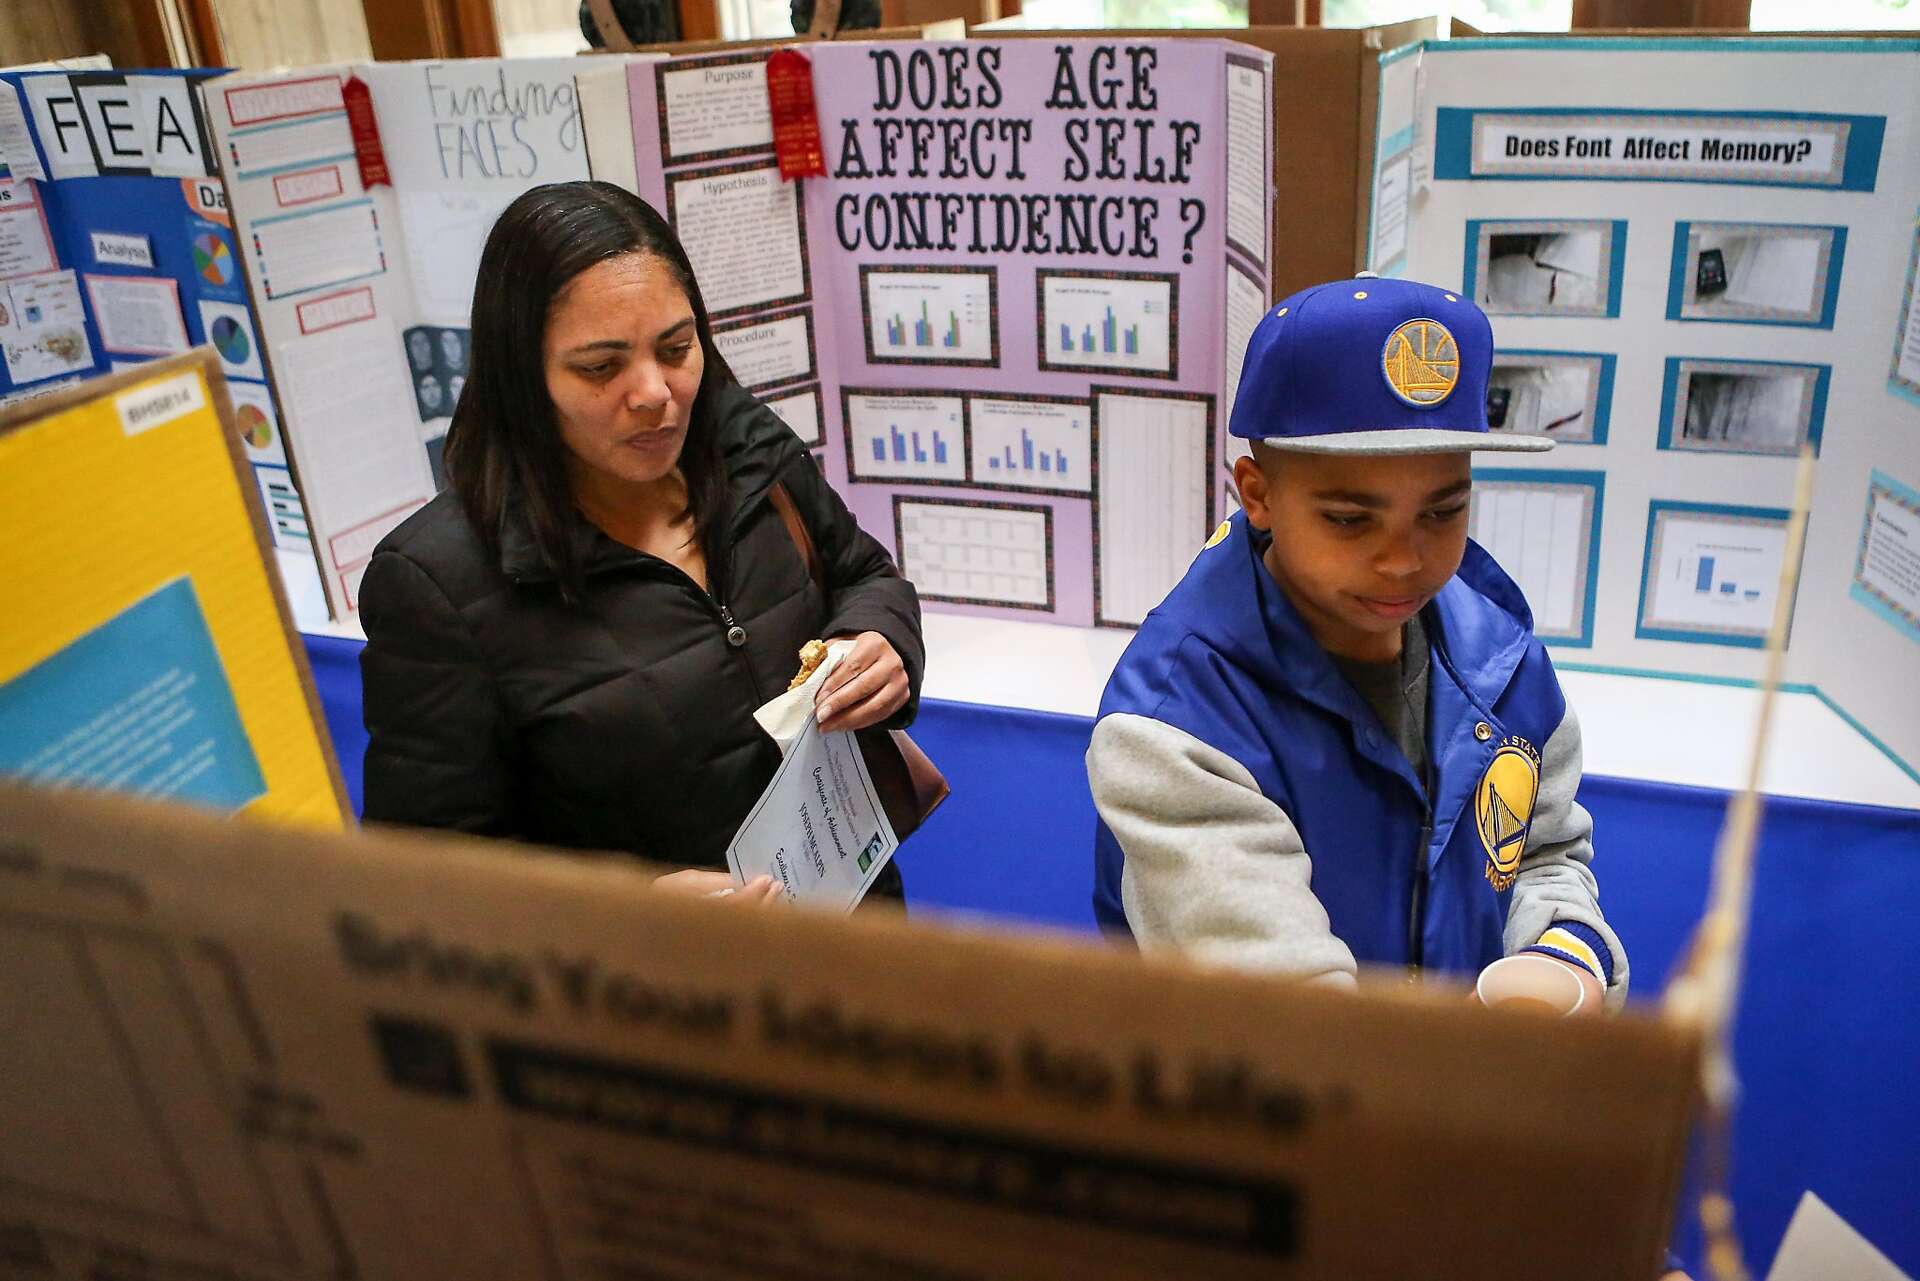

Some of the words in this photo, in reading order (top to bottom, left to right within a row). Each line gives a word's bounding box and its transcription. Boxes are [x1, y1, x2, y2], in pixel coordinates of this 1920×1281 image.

[705, 70, 754, 84] Purpose
[869, 47, 1001, 112] DOES
[1045, 46, 1158, 111] AGE
[426, 65, 577, 152] Finding
[434, 115, 538, 178] FACES
[834, 119, 1032, 180] AFFECT
[1064, 119, 1200, 183] SELF
[1505, 136, 1559, 158] Does
[1566, 137, 1612, 159] Font
[1624, 138, 1690, 162] Affect
[1701, 139, 1811, 164] Memory?
[703, 176, 768, 195] Hypothesis
[835, 193, 1159, 258] CONFIDENCE
[719, 328, 776, 347] Procedure
[1512, 735, 1541, 769] STATE
